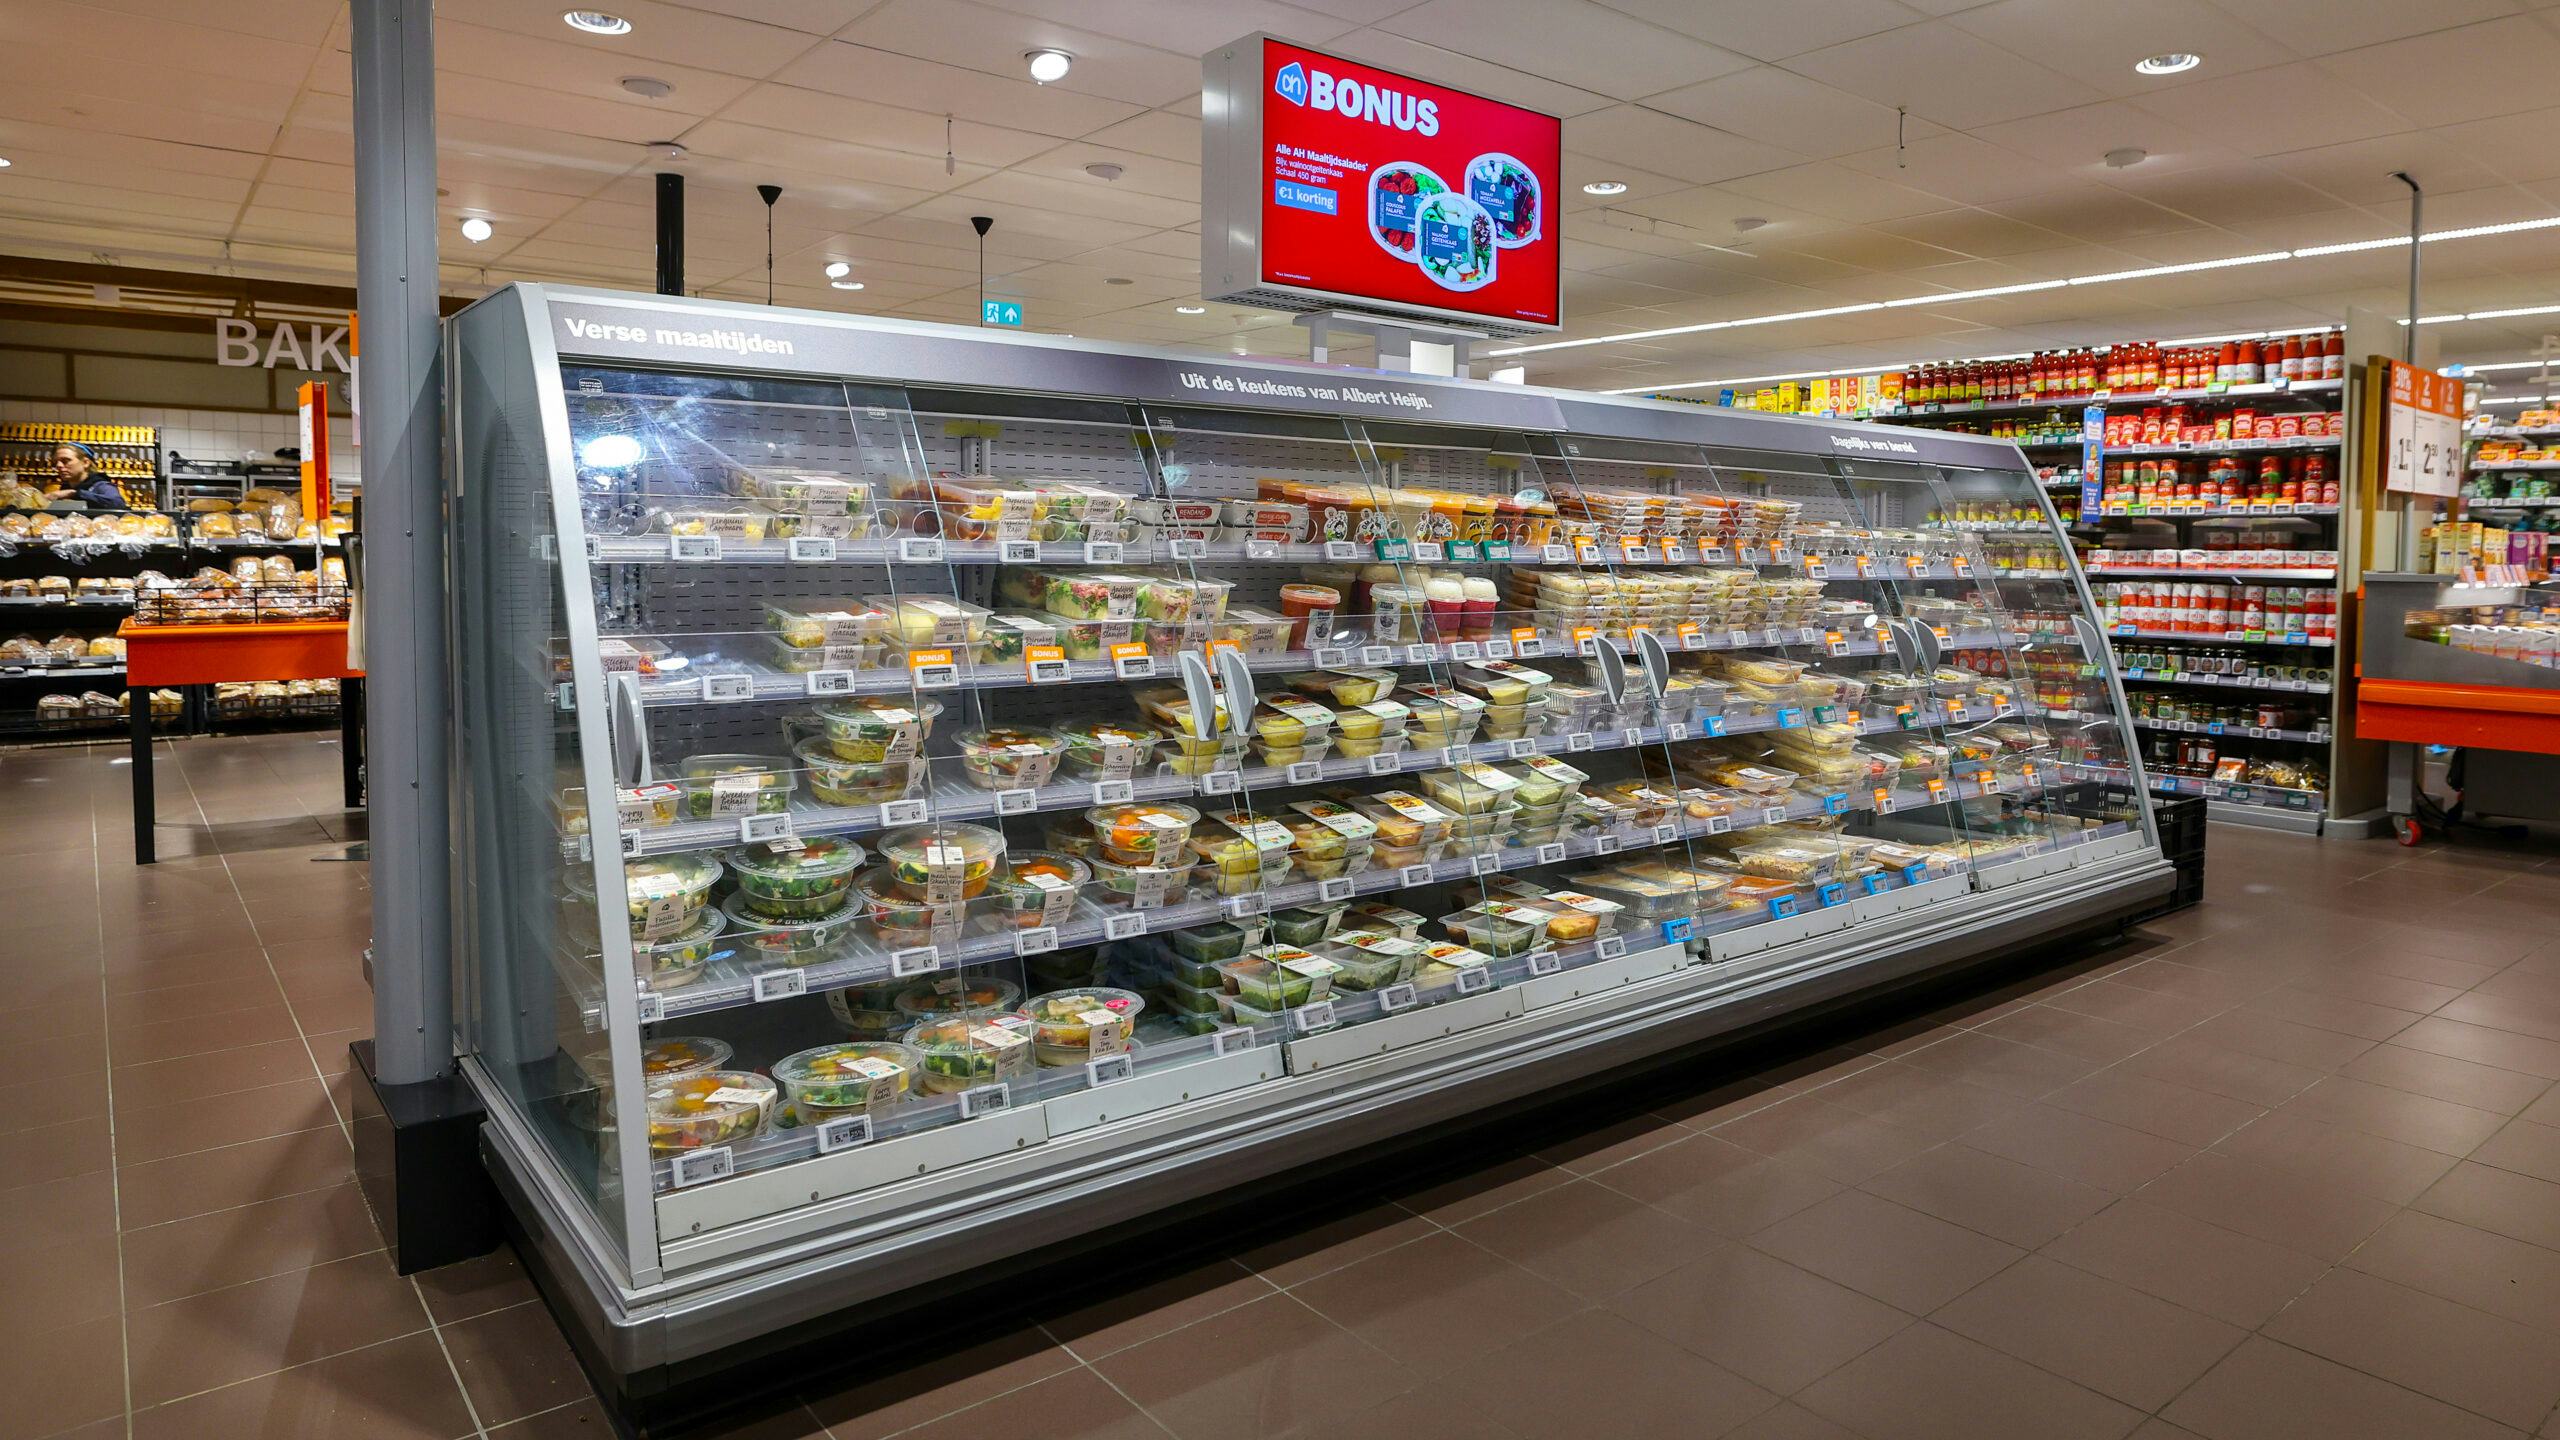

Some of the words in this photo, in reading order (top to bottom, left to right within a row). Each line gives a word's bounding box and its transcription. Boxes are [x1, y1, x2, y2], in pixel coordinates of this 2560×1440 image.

[1310, 69, 1440, 137] BONUS
[1275, 143, 1292, 156] Alle
[1293, 147, 1306, 159] AH
[1275, 166, 1297, 178] Schaal
[1297, 170, 1310, 181] 450
[1310, 175, 1327, 185] gram
[1278, 186, 1294, 200] €1
[1296, 188, 1334, 210] korting
[564, 317, 649, 344] Verse
[655, 326, 795, 356] maaltijden
[1179, 372, 1209, 391] Uit
[1212, 375, 1235, 393] de
[1236, 377, 1307, 399] keukens
[1308, 386, 1339, 401] van
[1342, 387, 1390, 406] Albert
[1390, 391, 1433, 411] Heijn.
[1830, 435, 1871, 451] Dagelijks
[1870, 440, 1887, 451] vers
[916, 653, 946, 662] BONUS
[1032, 650, 1059, 658] BONUS
[1116, 646, 1143, 655] BONUS
